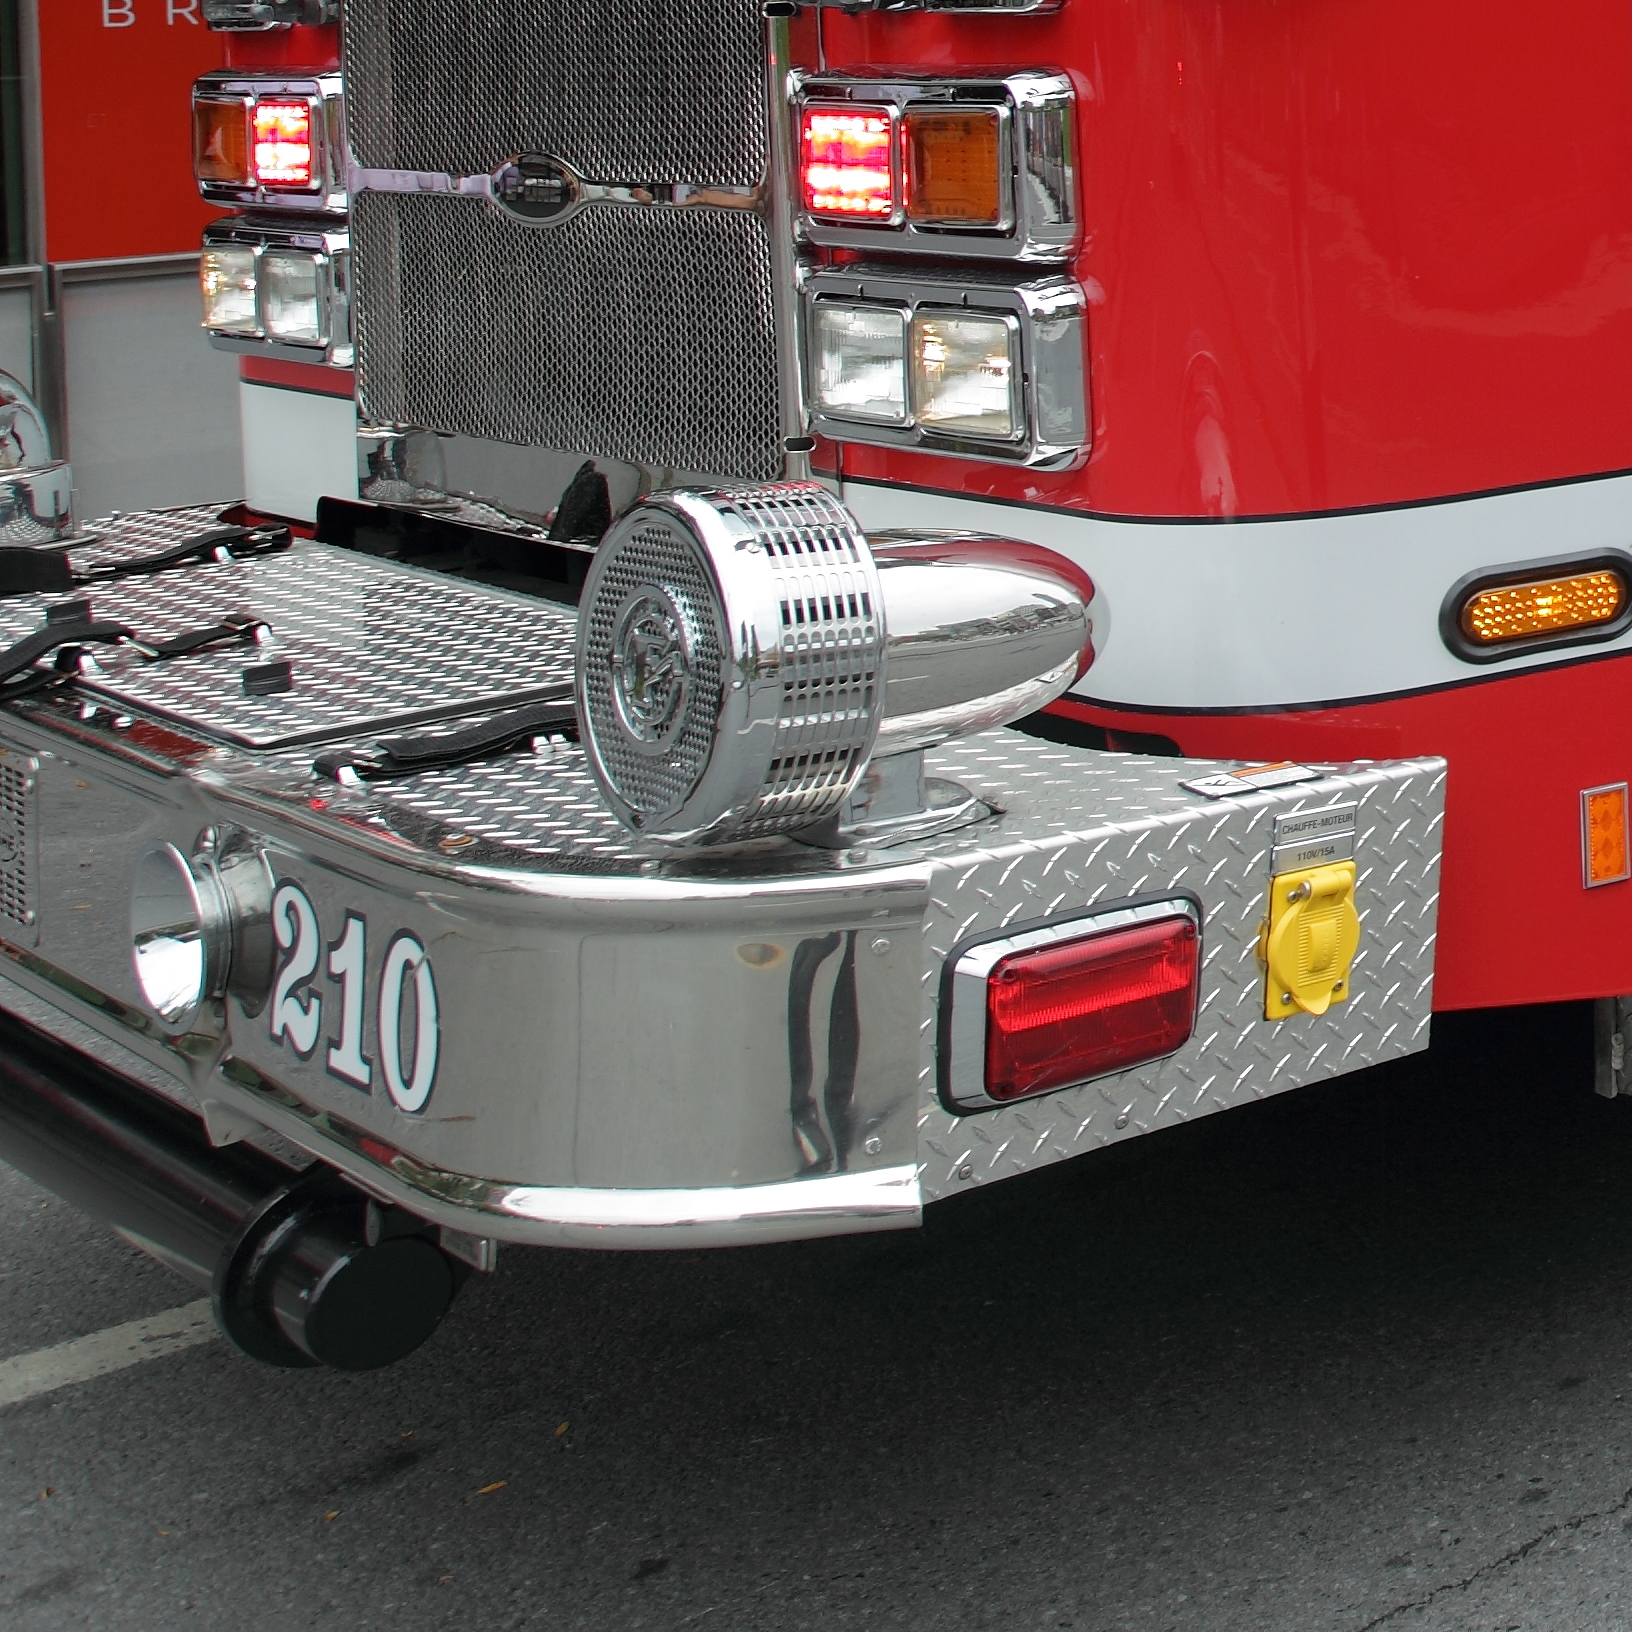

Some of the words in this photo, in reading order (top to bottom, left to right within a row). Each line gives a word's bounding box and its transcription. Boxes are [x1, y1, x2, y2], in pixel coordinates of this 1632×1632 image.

[1281, 812, 1354, 836] CHAUFFE-MOTEUR
[1296, 846, 1336, 861] 110V/15A
[270, 876, 441, 1116] 210
